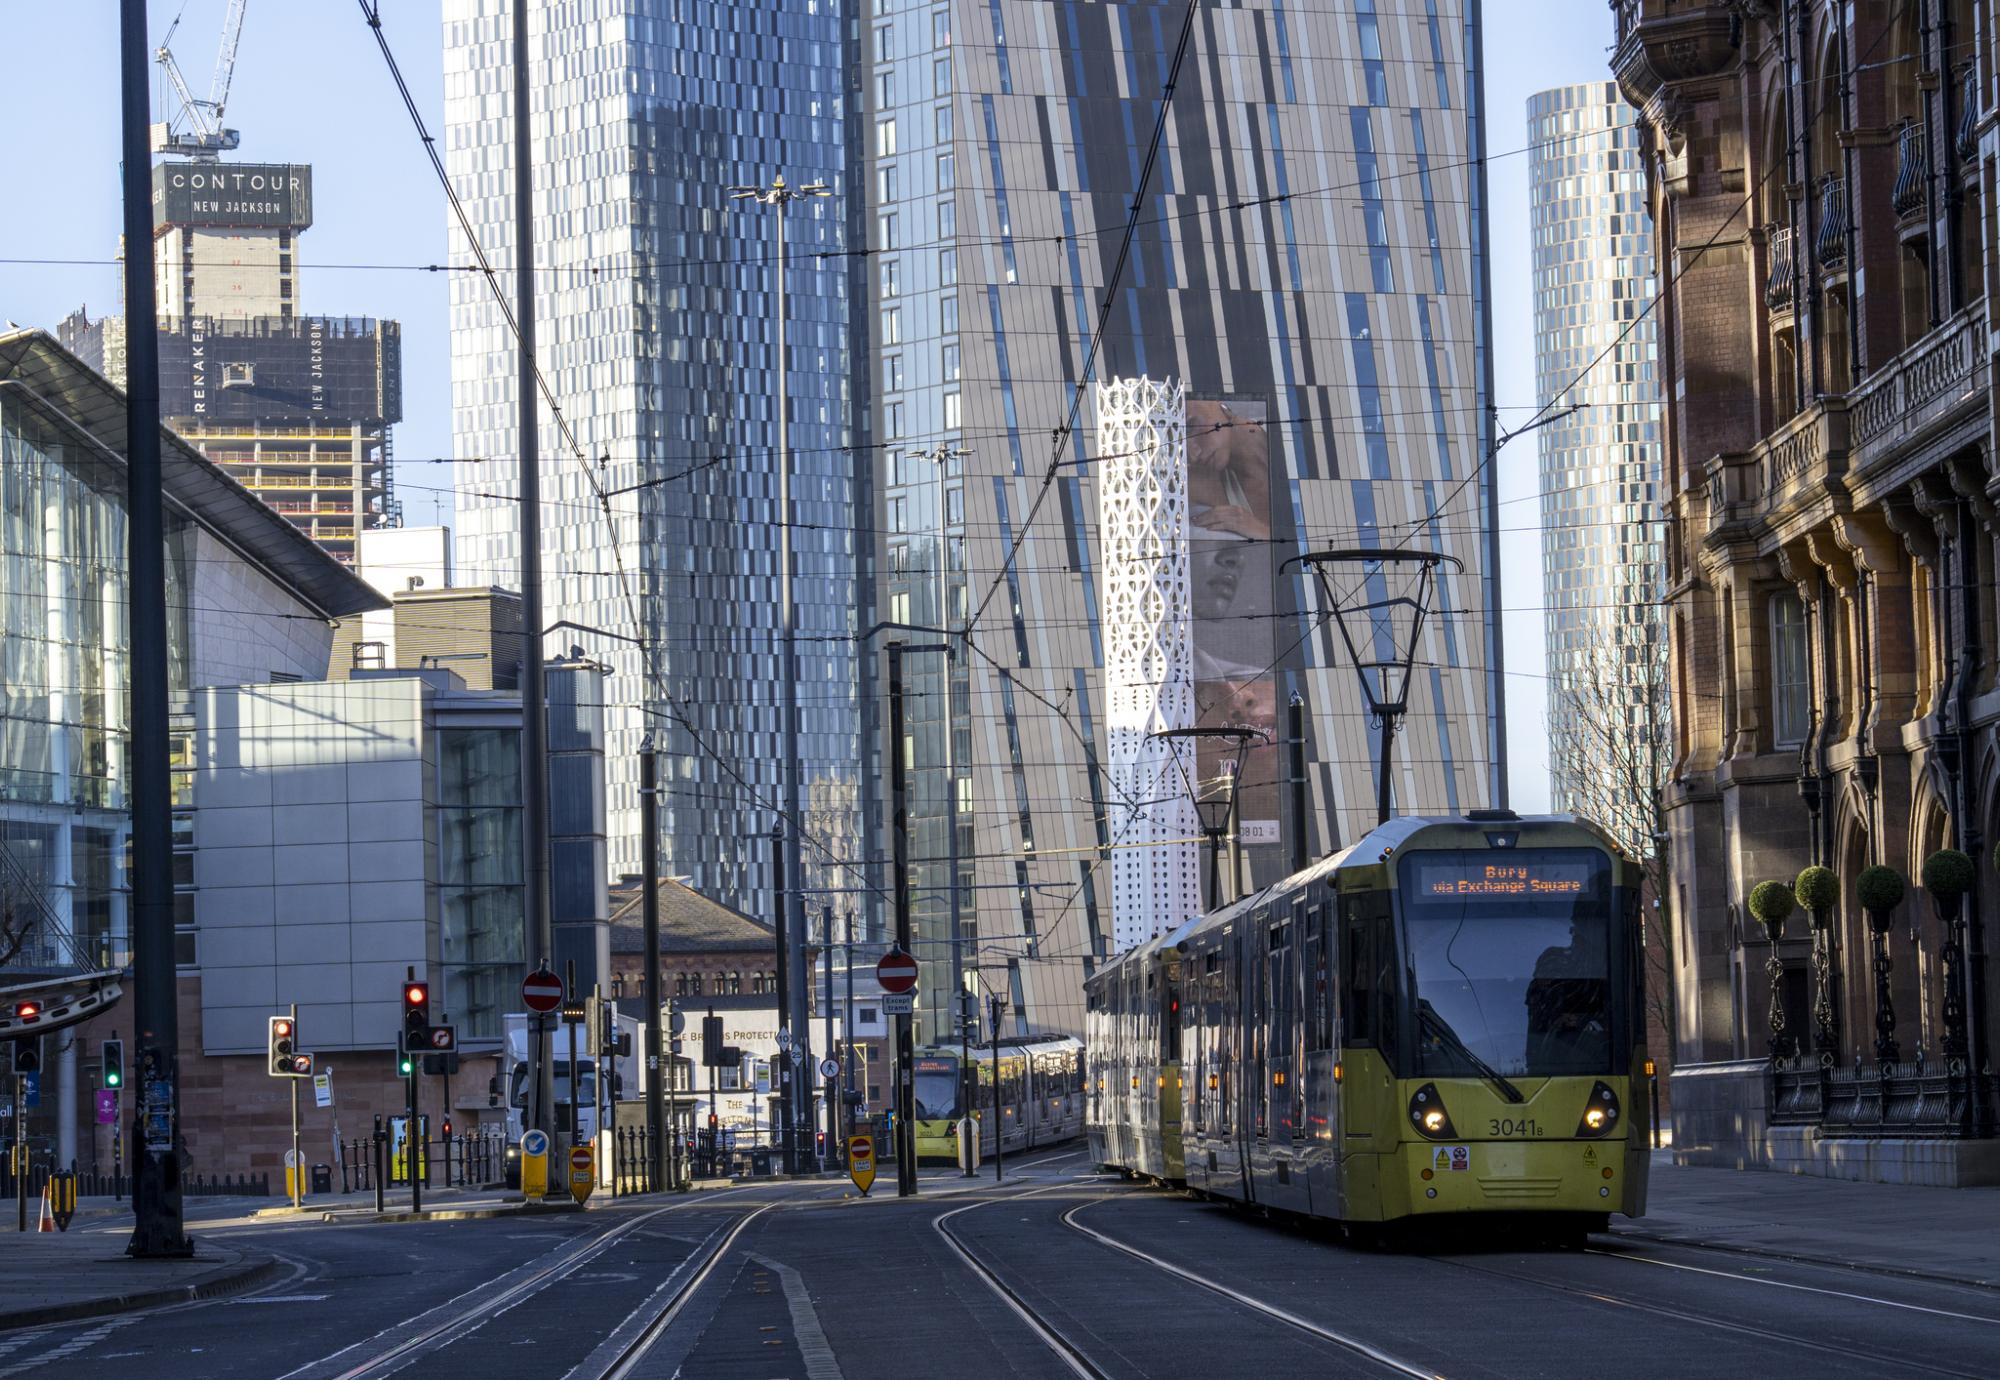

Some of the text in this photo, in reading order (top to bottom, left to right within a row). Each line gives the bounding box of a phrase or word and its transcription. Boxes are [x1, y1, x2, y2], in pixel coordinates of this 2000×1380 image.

[173, 174, 300, 191] CONTOUR
[194, 201, 280, 214] NEW JACKSON
[193, 319, 206, 413] RENAKER
[311, 322, 322, 410] NEW JACKSON
[1485, 865, 1527, 878] Bury
[1433, 879, 1581, 893] via Exchange Square
[886, 997, 910, 1005] Except
[779, 1034, 789, 1042] 10
[726, 1099, 743, 1109] THE
